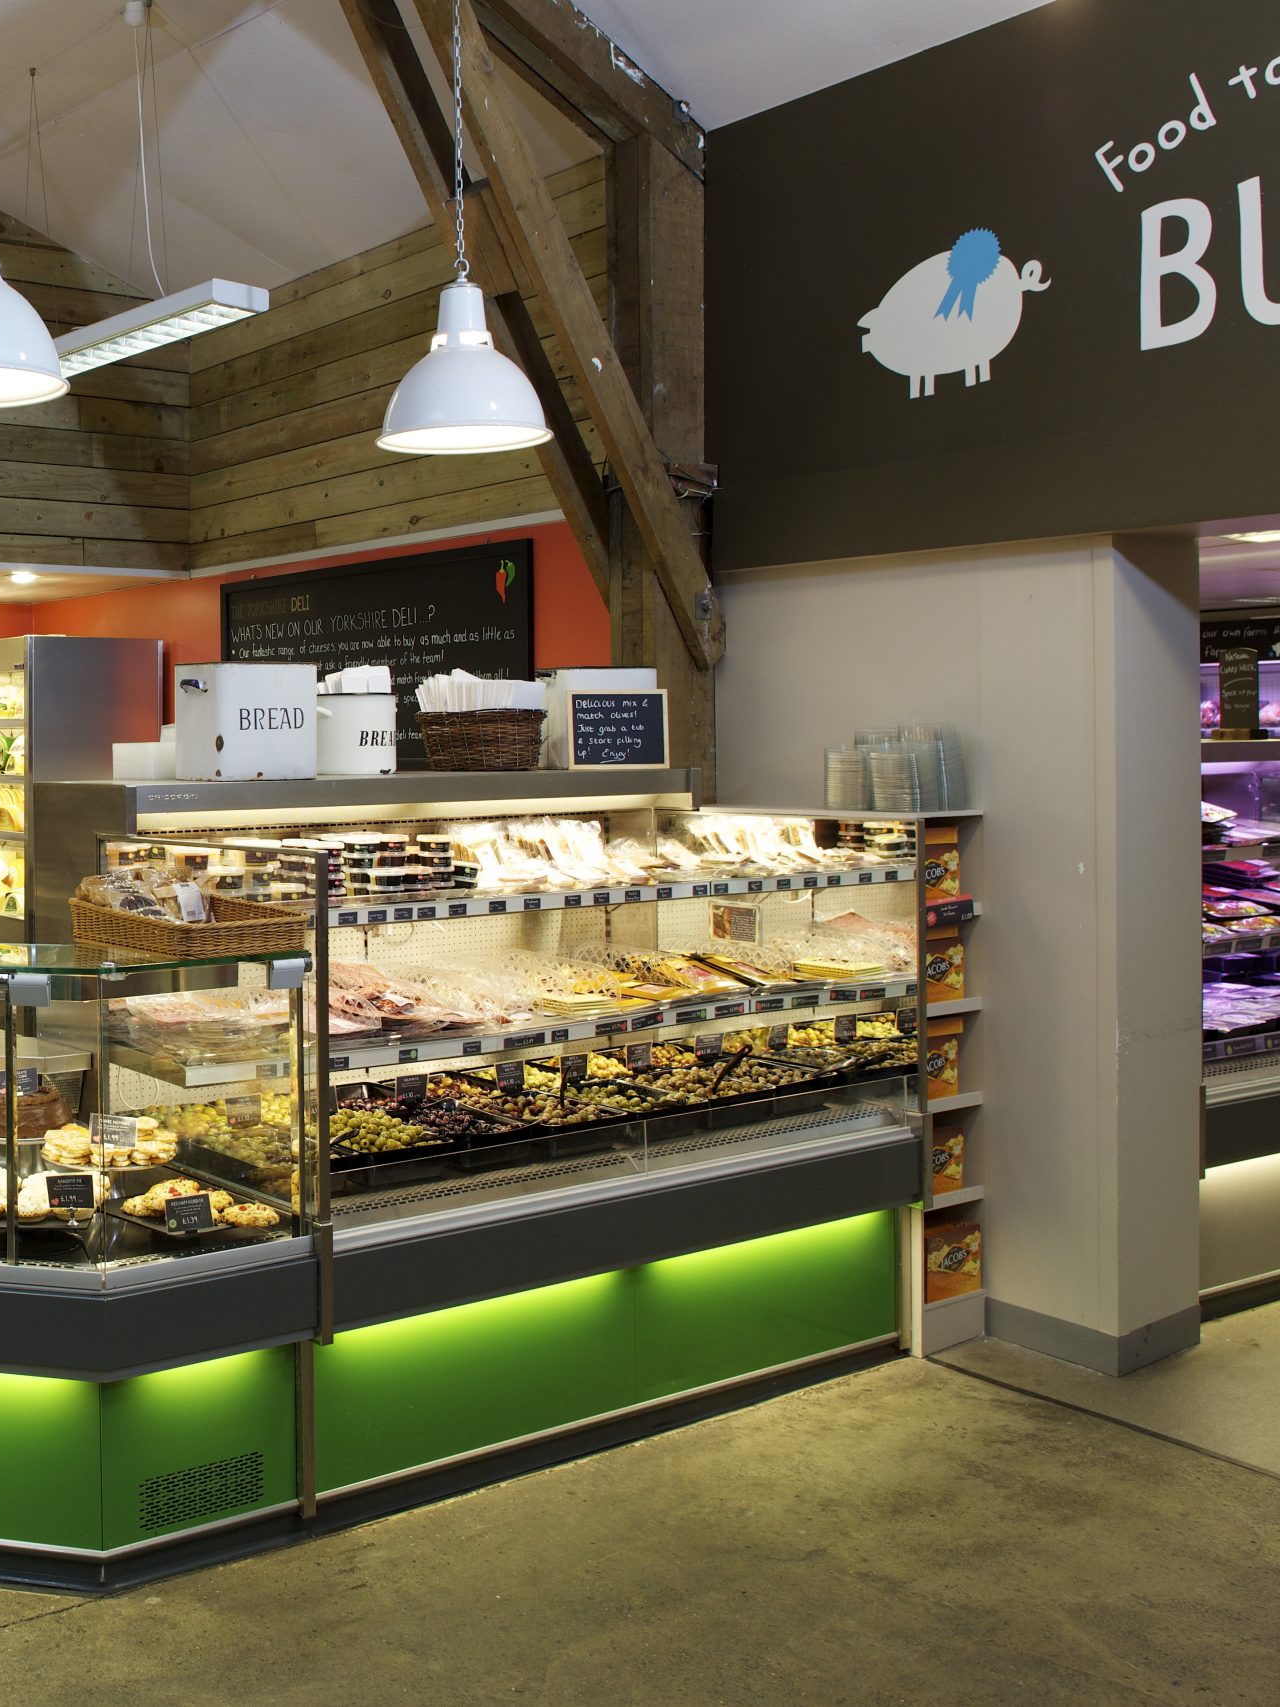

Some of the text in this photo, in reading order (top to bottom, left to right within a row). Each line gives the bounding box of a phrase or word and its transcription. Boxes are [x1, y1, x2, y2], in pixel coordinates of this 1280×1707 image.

[1095, 72, 1217, 192] Food
[291, 595, 310, 612] DELI
[231, 624, 262, 643] WHAT'S
[265, 622, 285, 640] NEW
[287, 621, 300, 638] ON
[303, 619, 324, 636] OUR
[330, 609, 387, 633] YORKSHIRE
[1202, 630, 1218, 639] our
[1222, 629, 1241, 637] own
[278, 646, 296, 660] range
[300, 640, 307, 654] of
[338, 642, 349, 655] you
[349, 641, 361, 651] are
[361, 639, 374, 649] now
[377, 634, 391, 648] able
[394, 636, 402, 647] to
[403, 633, 416, 650] buy
[420, 635, 429, 646] as
[431, 629, 451, 645] much
[453, 628, 468, 642] and
[469, 631, 480, 642] as
[482, 625, 502, 641] little
[503, 628, 516, 640] as
[324, 659, 336, 670] ask
[400, 652, 408, 666] of
[410, 651, 421, 664] the
[422, 649, 444, 664] team!
[575, 698, 648, 709] Delicious mix &
[239, 707, 305, 731] BREAD
[576, 710, 637, 720] match olives!
[577, 724, 594, 733] Just
[597, 725, 616, 736] grab
[631, 723, 644, 731] tub
[358, 730, 396, 747] BREA
[616, 735, 641, 748] filling
[927, 961, 950, 977] ACOB'S
[60, 1194, 77, 1202] £1.99
[182, 1215, 198, 1225] £1.39
[940, 1249, 968, 1271] JACOB'S
